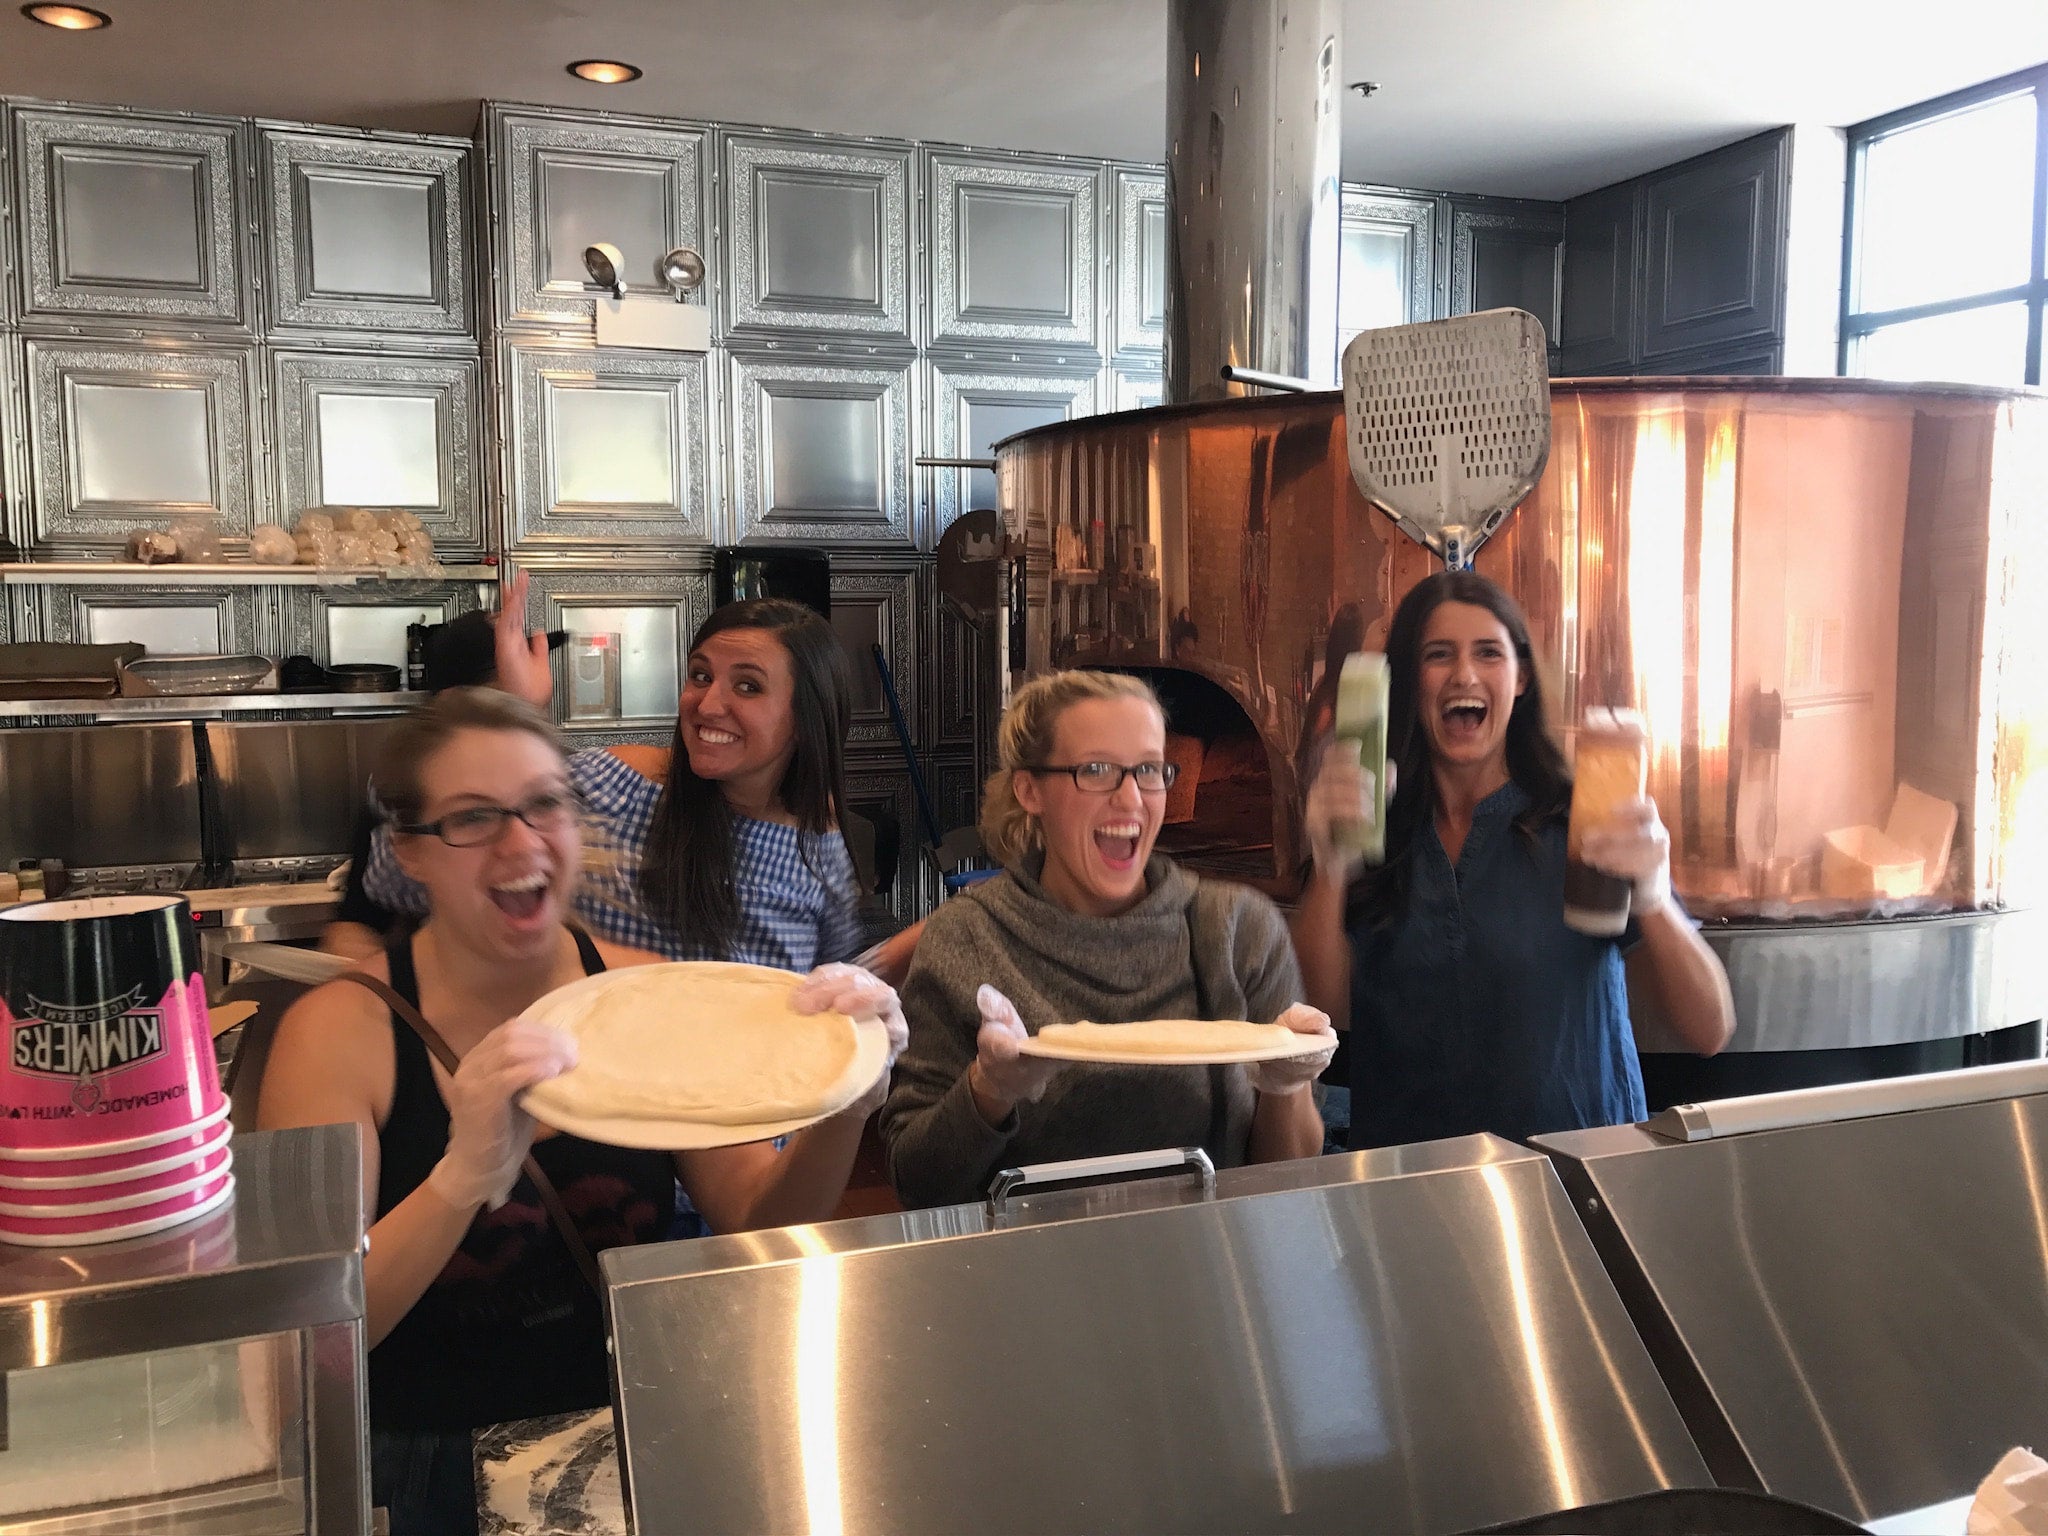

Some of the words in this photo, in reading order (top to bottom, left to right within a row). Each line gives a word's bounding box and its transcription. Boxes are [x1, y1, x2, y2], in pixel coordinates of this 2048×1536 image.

[45, 1009, 96, 1022] CREAM
[100, 1000, 125, 1018] ICE
[15, 1016, 160, 1073] KIMMER'S
[32, 1106, 75, 1120] WITH
